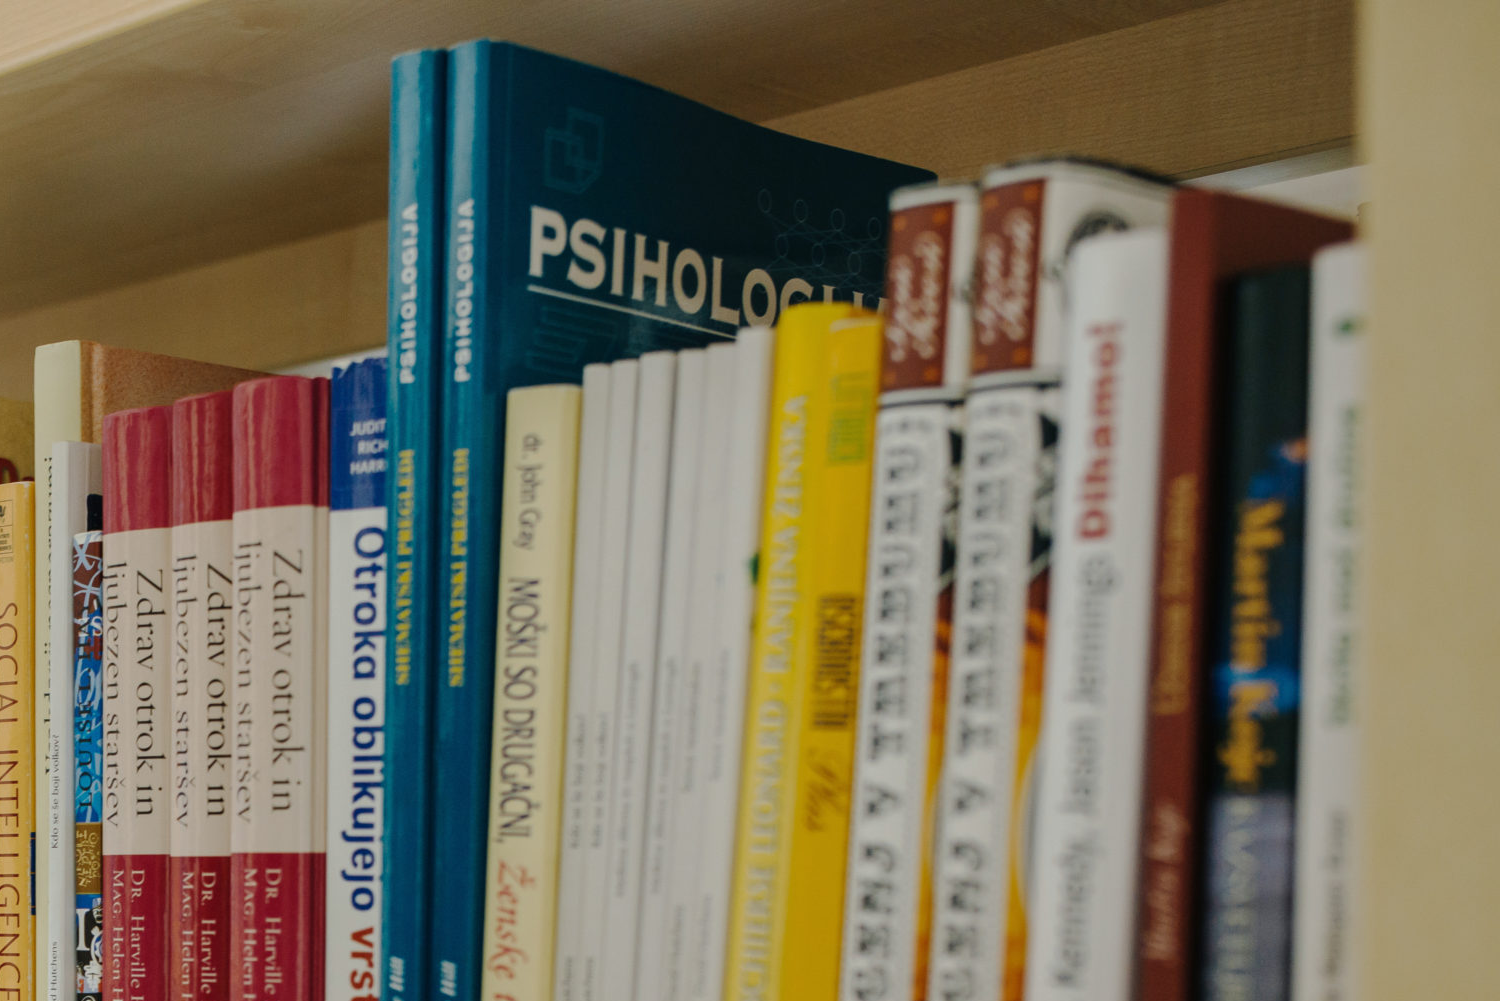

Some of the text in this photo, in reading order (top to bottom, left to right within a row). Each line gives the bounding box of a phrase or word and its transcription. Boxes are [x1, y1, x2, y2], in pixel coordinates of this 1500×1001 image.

[399, 202, 420, 385] PSIHOLOGIJA
[453, 198, 475, 384] PSIHOLOGIJA
[206, 562, 233, 668] Zdrav
[352, 526, 388, 680] Otroka
[504, 577, 548, 660] MOŠKI
[1228, 500, 1284, 668] Martin
[101, 561, 128, 830] ljubezen staršev
[134, 568, 166, 818] Zdrav otrok in
[172, 554, 198, 830] ljubezen staršev
[206, 677, 232, 772] otrok
[233, 540, 264, 825] ljubezen staršev
[270, 548, 306, 813] Zdrav otrok in
[502, 665, 540, 701] SO
[341, 696, 384, 911] oblikujejo
[49, 941, 59, 991] Hutchens
[111, 926, 125, 980] Helen
[129, 915, 146, 989] Harville
[180, 930, 195, 985] Helen
[200, 918, 217, 994] Harville
[242, 927, 258, 986] Helen
[263, 916, 282, 995] Harville
[388, 956, 405, 992] Hill
[439, 960, 458, 997] Hill
